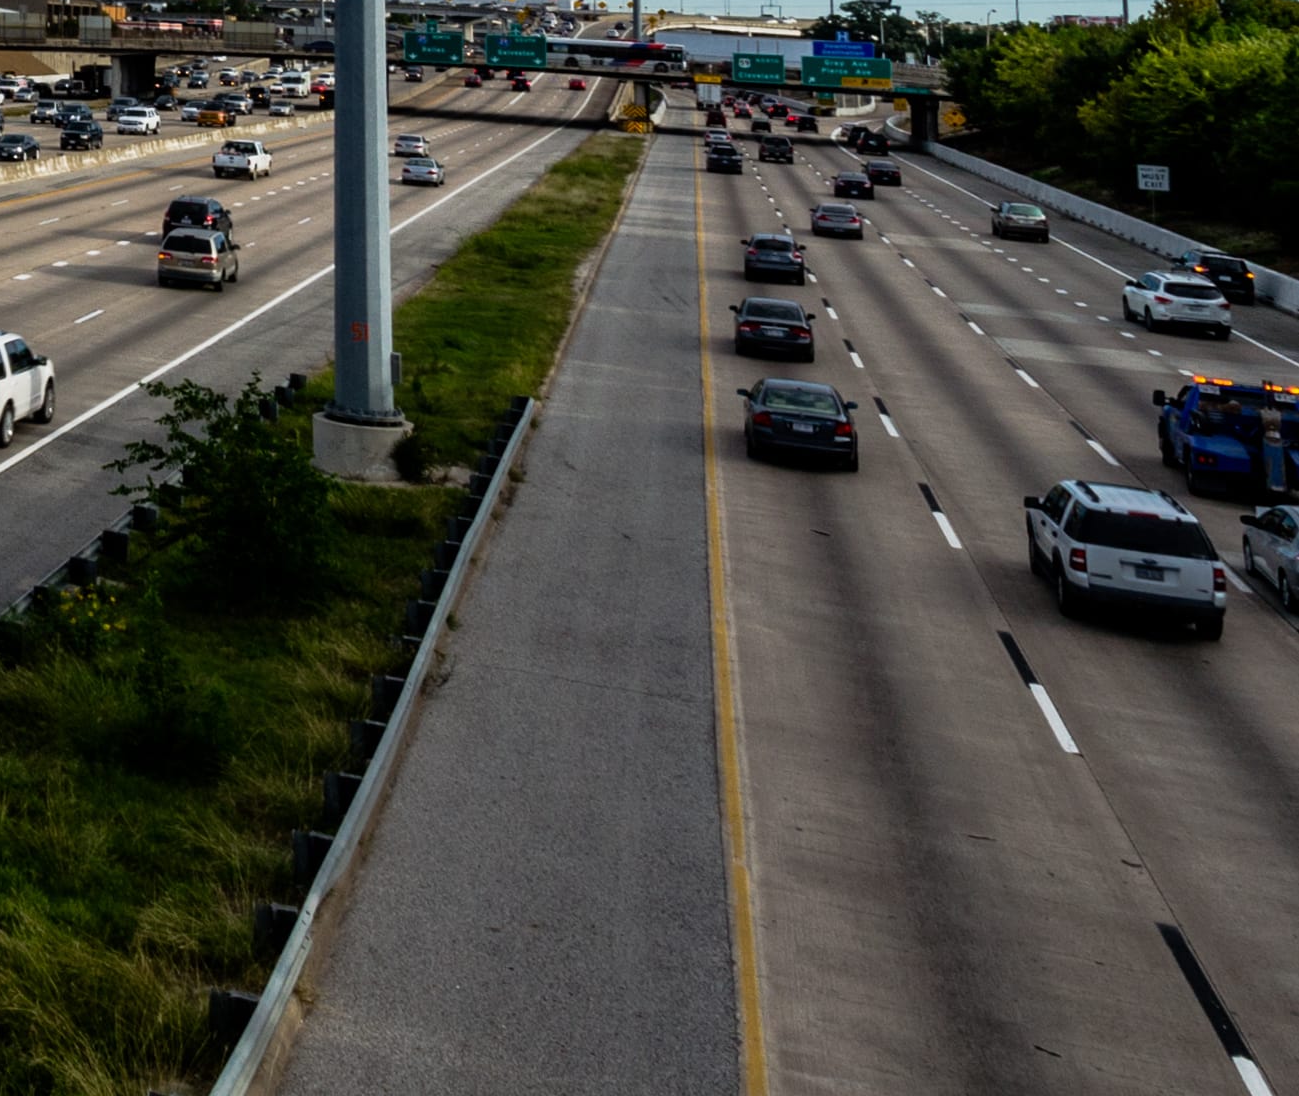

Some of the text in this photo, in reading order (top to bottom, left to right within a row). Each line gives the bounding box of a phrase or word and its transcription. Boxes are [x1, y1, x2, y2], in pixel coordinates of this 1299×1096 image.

[837, 31, 849, 41] H
[738, 71, 780, 80] Cleveland
[1141, 173, 1165, 181] MUST
